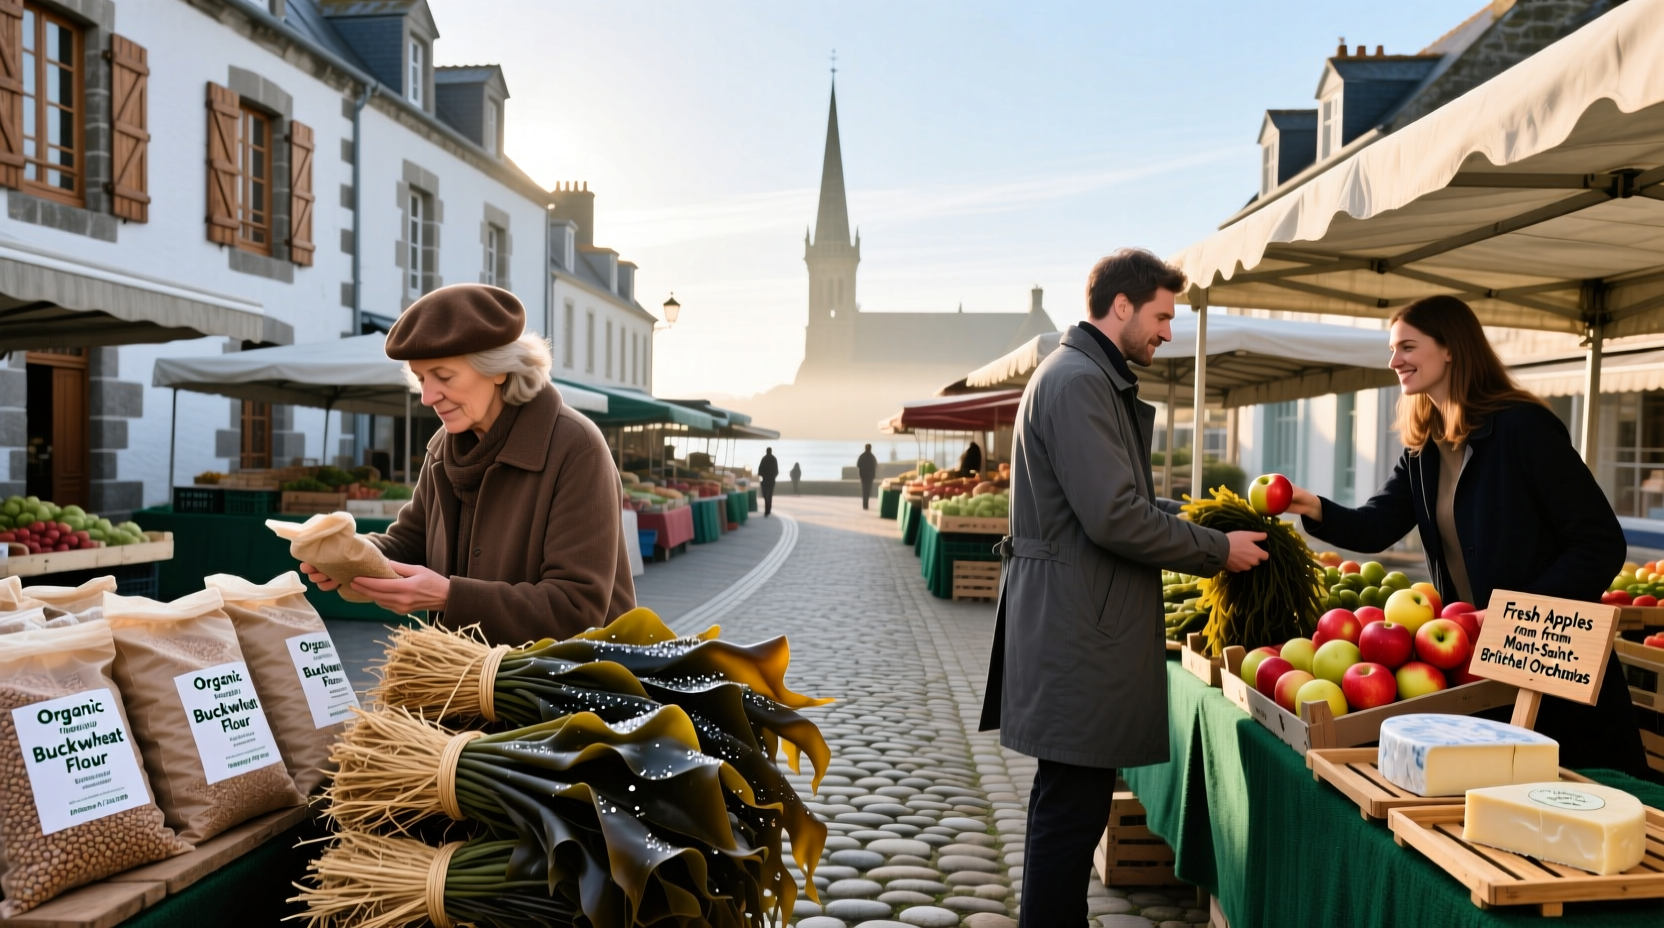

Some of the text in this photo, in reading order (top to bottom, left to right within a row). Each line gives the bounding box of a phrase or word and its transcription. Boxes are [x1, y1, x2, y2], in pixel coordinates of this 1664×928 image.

[1503, 601, 1594, 633] Fresh Apples
[37, 699, 104, 725] Organic
[221, 717, 250, 733] Flour
[32, 728, 124, 763] Buckwheat
[65, 753, 108, 773] Flour
